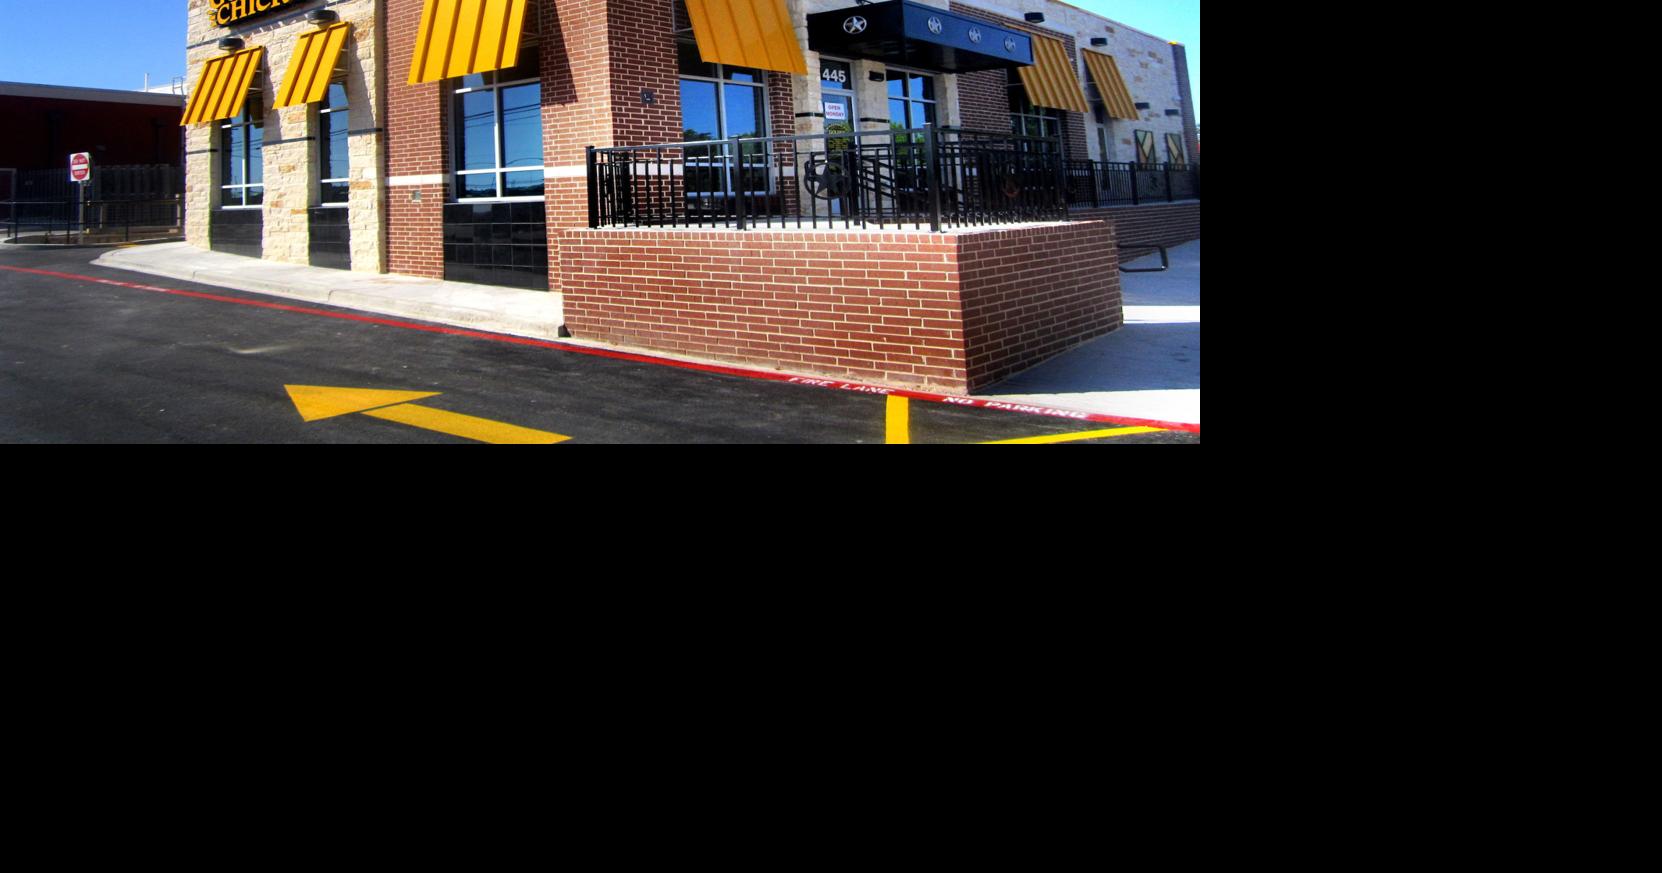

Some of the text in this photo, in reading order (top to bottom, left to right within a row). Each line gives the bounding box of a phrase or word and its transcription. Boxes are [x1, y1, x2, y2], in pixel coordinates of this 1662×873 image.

[823, 68, 846, 83] 445
[788, 377, 895, 394] FIRE LANE
[942, 396, 1088, 418] NO PARKING
